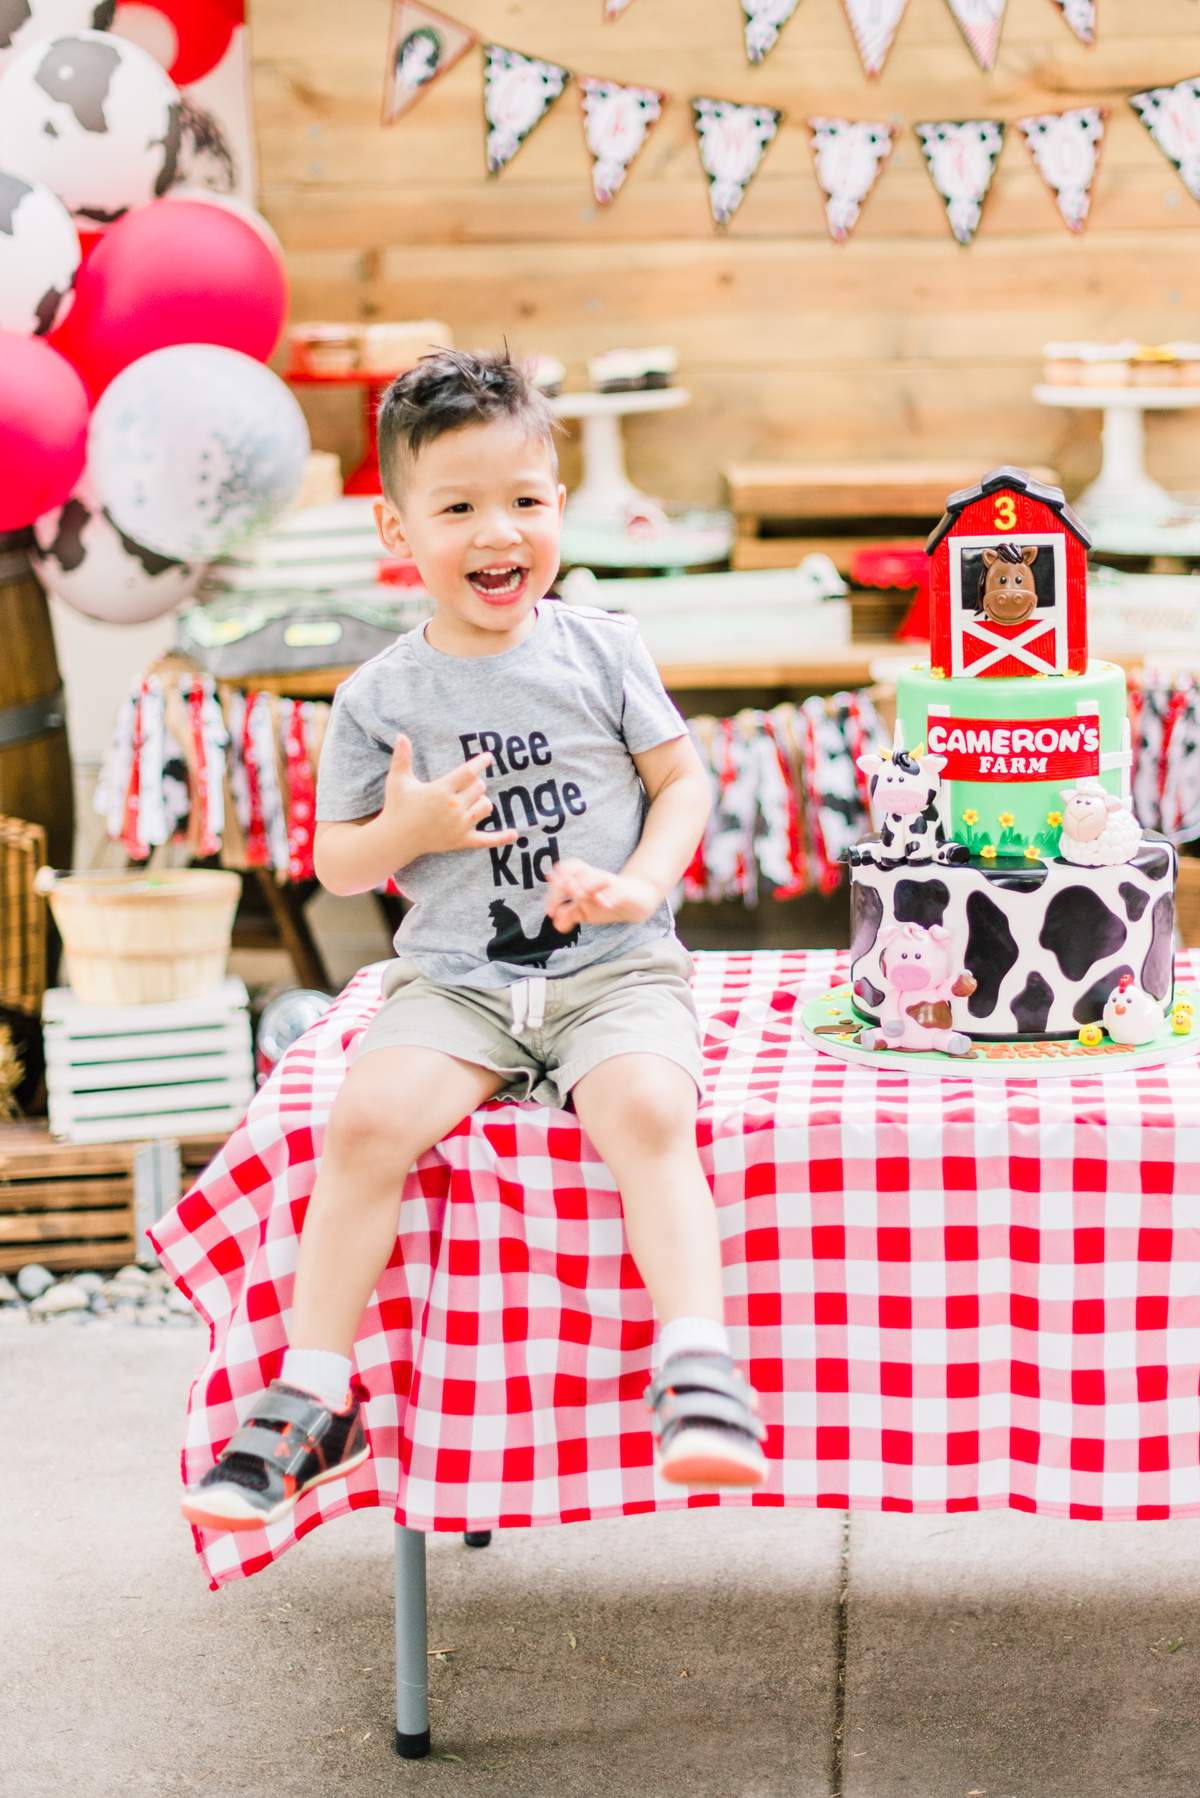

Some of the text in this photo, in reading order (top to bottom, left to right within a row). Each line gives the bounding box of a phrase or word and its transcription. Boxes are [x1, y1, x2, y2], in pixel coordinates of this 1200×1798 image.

[994, 496, 1017, 530] 3
[928, 723, 1099, 754] CAMERON'S
[979, 756, 1048, 774] FARM
[475, 779, 587, 834] ange
